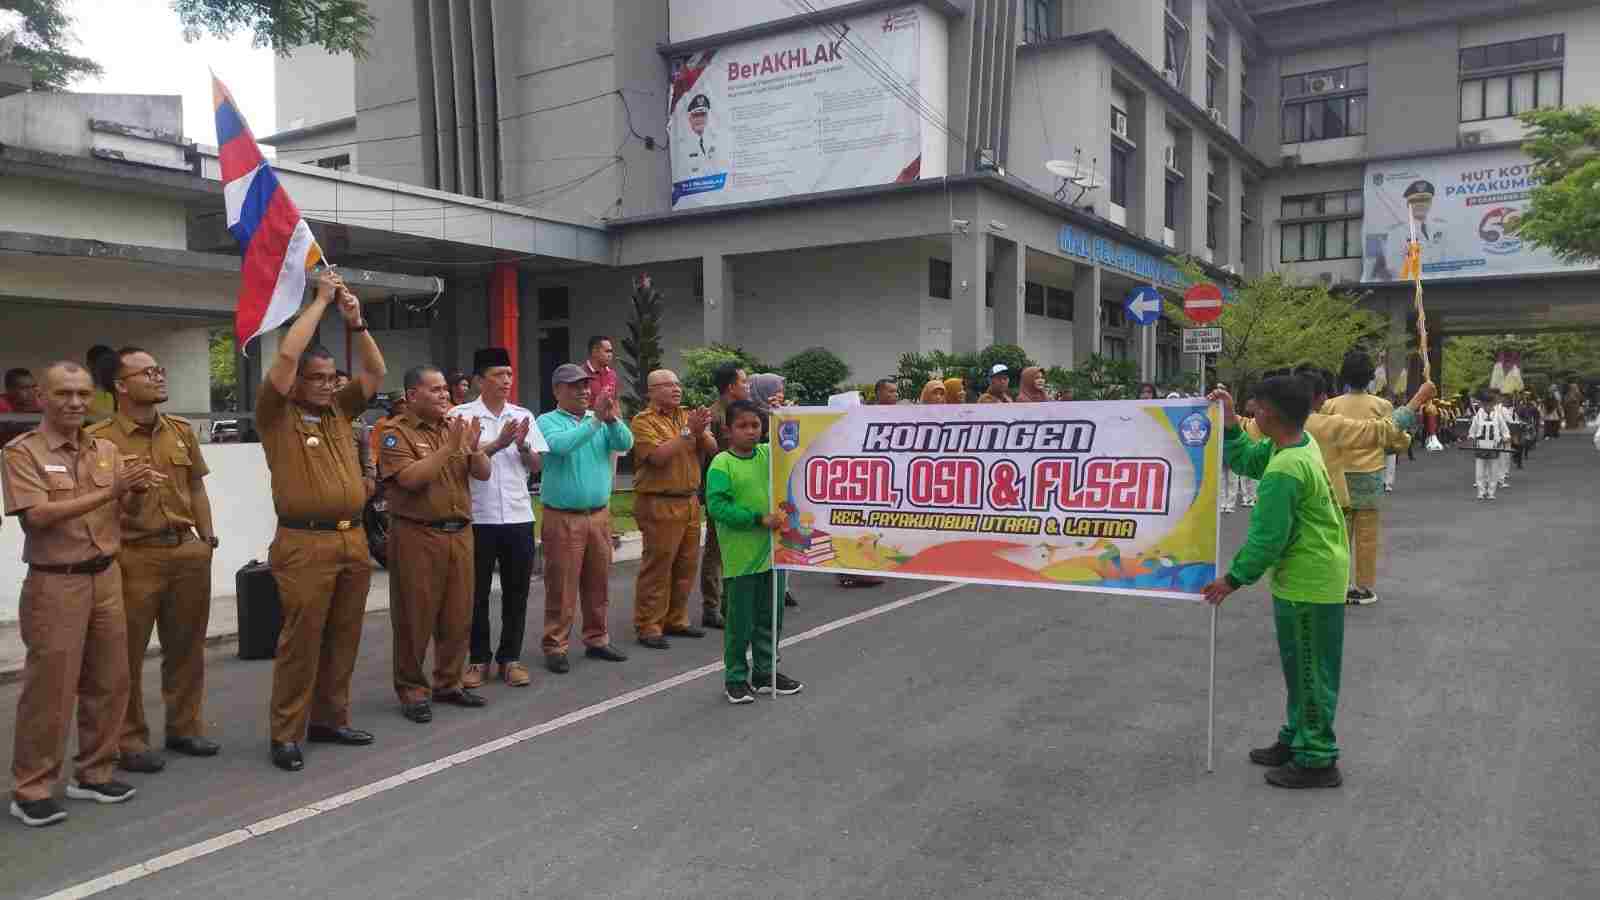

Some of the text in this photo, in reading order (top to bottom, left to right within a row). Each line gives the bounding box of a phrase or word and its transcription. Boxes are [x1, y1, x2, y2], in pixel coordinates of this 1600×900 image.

[727, 41, 842, 81] BerAKHLAK
[1461, 169, 1494, 182] HUT
[864, 421, 1095, 453] KONTINGEN
[908, 457, 985, 509] OSN
[987, 459, 1026, 511] &
[1029, 457, 1172, 515] FLS2N
[830, 508, 1137, 539] KEC. PAYAKUMBUH UTARA & LATINA
